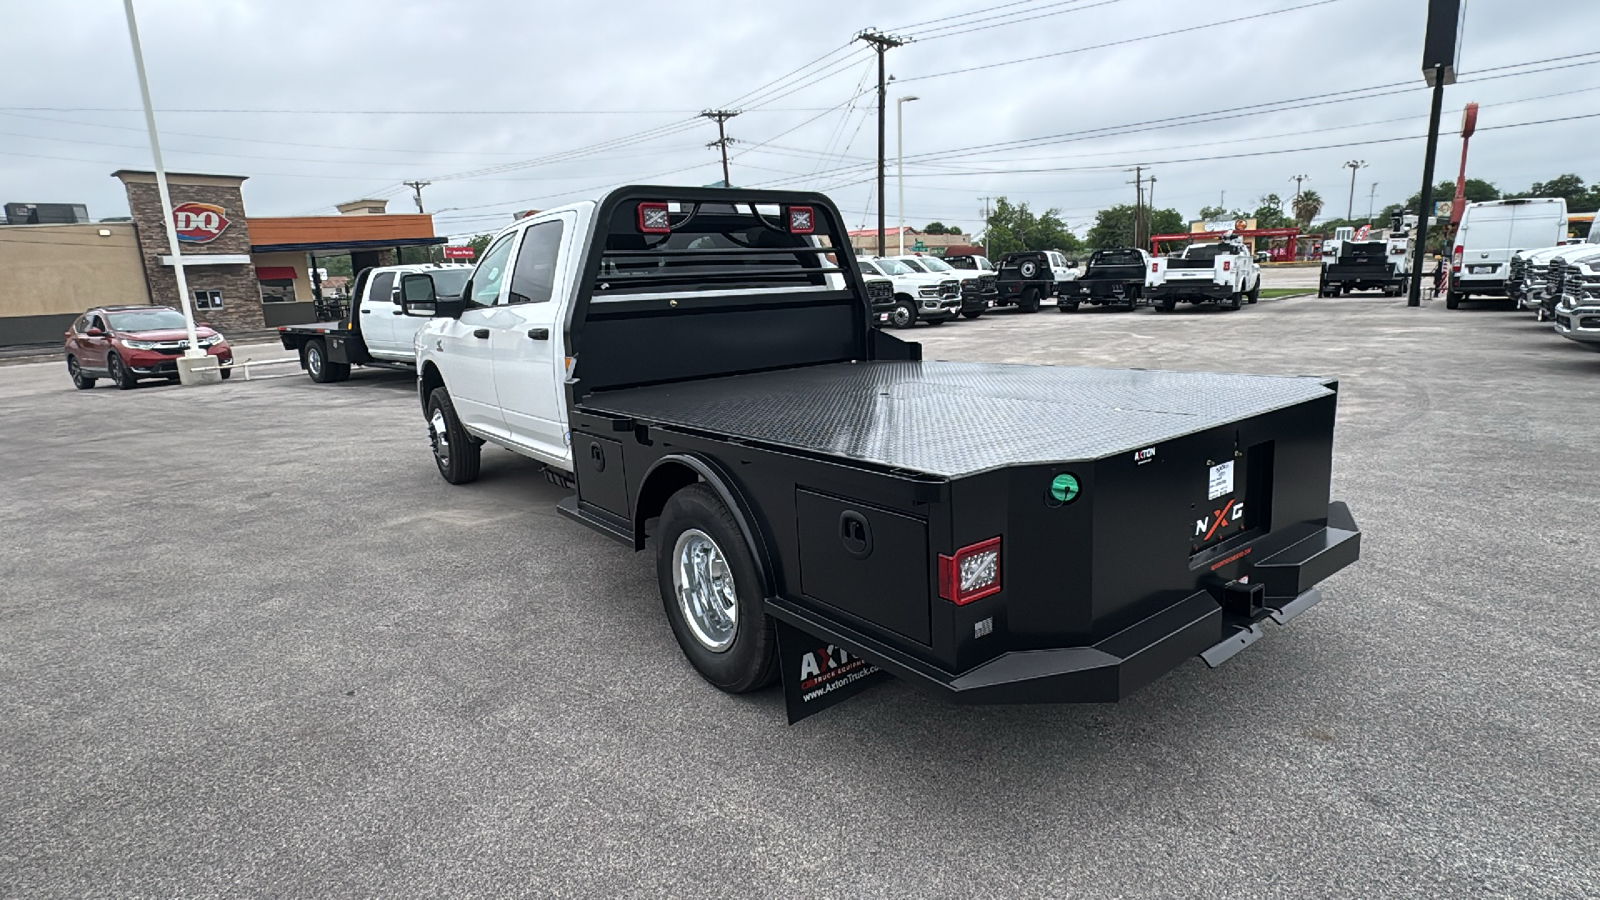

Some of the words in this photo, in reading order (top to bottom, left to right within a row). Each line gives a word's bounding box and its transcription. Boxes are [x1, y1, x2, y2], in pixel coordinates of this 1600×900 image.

[175, 211, 220, 234] DQ
[1134, 446, 1156, 461] AXTON
[1195, 499, 1244, 541] NXG
[800, 644, 859, 681] AXT
[802, 665, 882, 703] www.AxtonTruck.co
[813, 672, 836, 685] TRUCK
